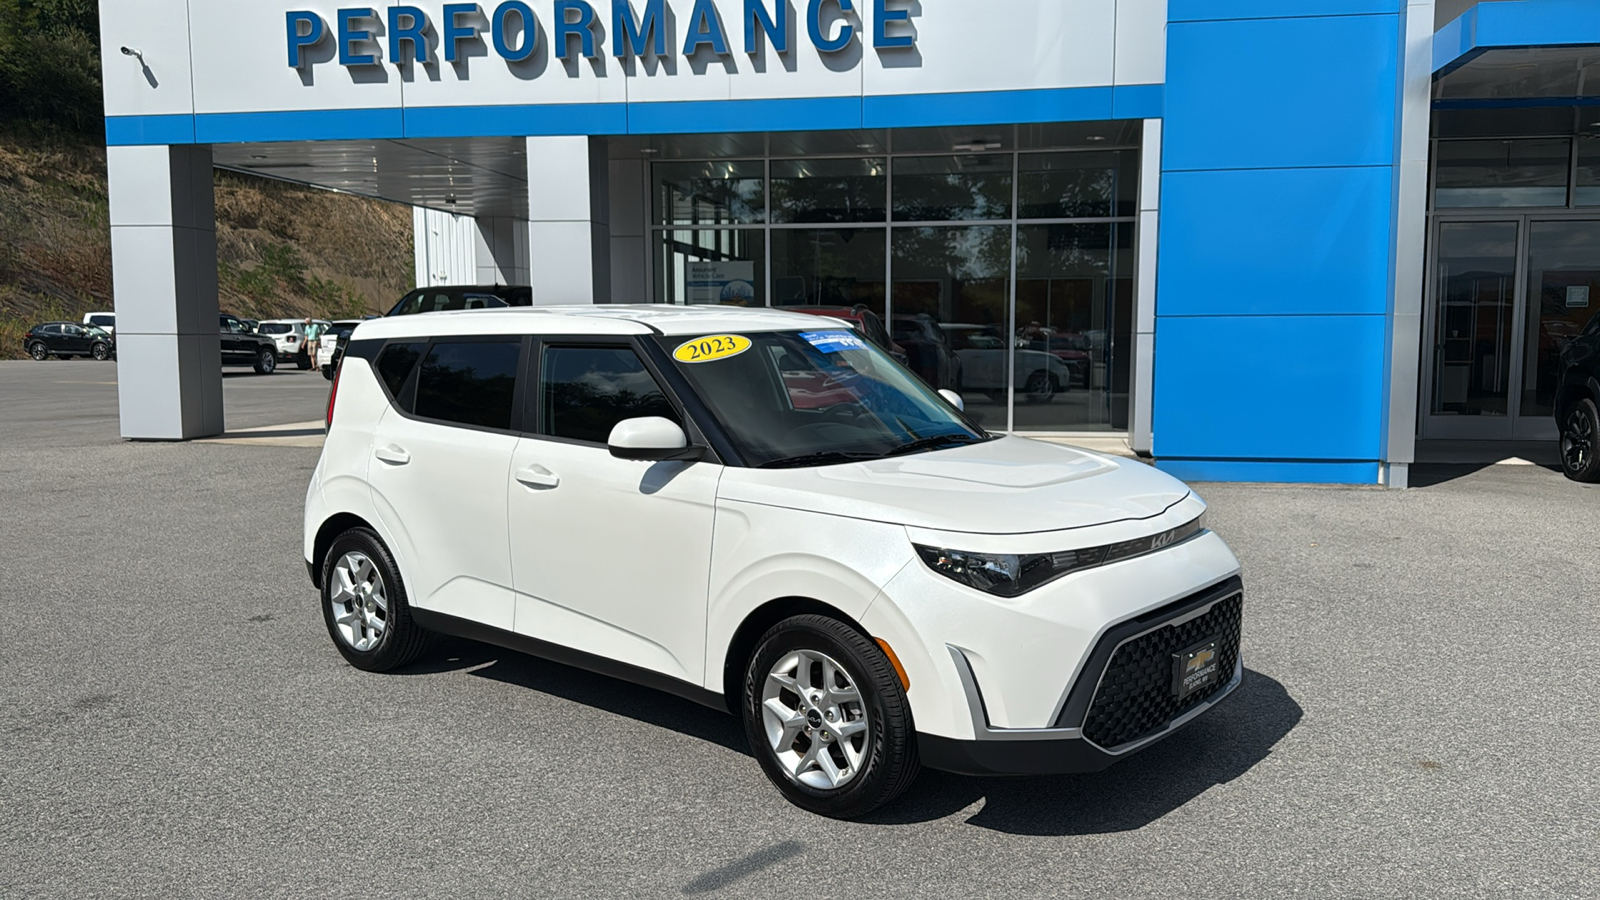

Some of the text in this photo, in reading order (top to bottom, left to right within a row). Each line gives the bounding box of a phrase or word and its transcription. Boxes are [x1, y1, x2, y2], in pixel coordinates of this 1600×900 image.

[285, 0, 915, 68] PERFORMANCE
[687, 336, 737, 359] 2023
[1183, 663, 1217, 687] PERFORMANCE
